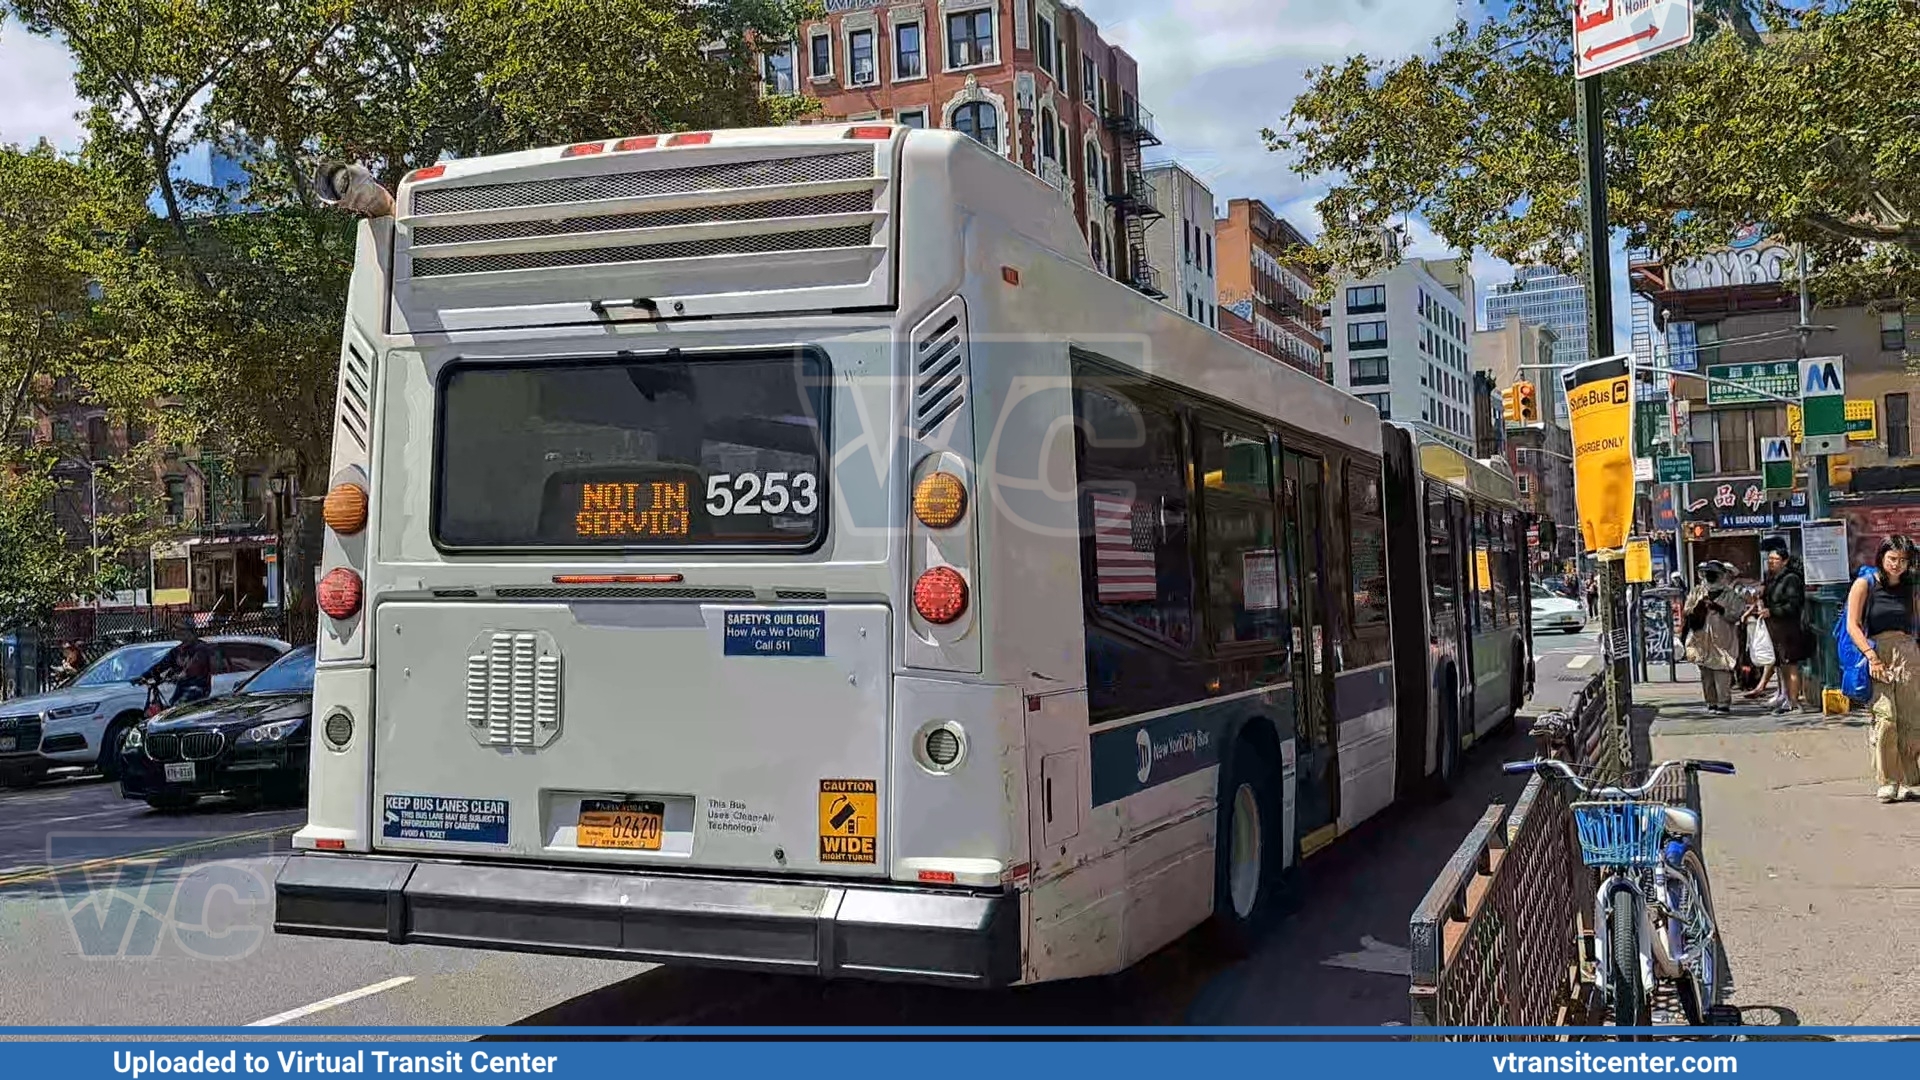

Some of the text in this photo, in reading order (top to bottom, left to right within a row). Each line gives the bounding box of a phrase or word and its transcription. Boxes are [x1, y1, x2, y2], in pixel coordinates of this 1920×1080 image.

[1589, 390, 1610, 405] Bus
[1602, 436, 1625, 450] ONLY
[583, 483, 687, 510] NOT IN
[706, 472, 818, 517] 5253
[1736, 516, 1765, 524] SEAFOOD
[728, 613, 821, 625] SAFETY'S OUR GOAL
[727, 627, 820, 639] How Are We Doing?
[755, 640, 790, 651] Call 511
[1153, 730, 1210, 760] New York City Bus
[823, 782, 874, 792] CAUTION
[386, 797, 505, 814] KEEP BUS LANES CLEAR
[708, 800, 747, 810] This Bus
[401, 811, 505, 824] THIS BUS LANE MAY BE SUBJECT TO
[708, 811, 774, 823] Uses Clean-Air
[401, 820, 480, 830] ENFORCEMENT BY CAMERA
[708, 822, 758, 833] Technology
[401, 829, 418, 837] AVOID
[426, 830, 446, 839] TICKET
[823, 837, 873, 853] WIDE
[822, 853, 873, 862] RIGHT TURNS
